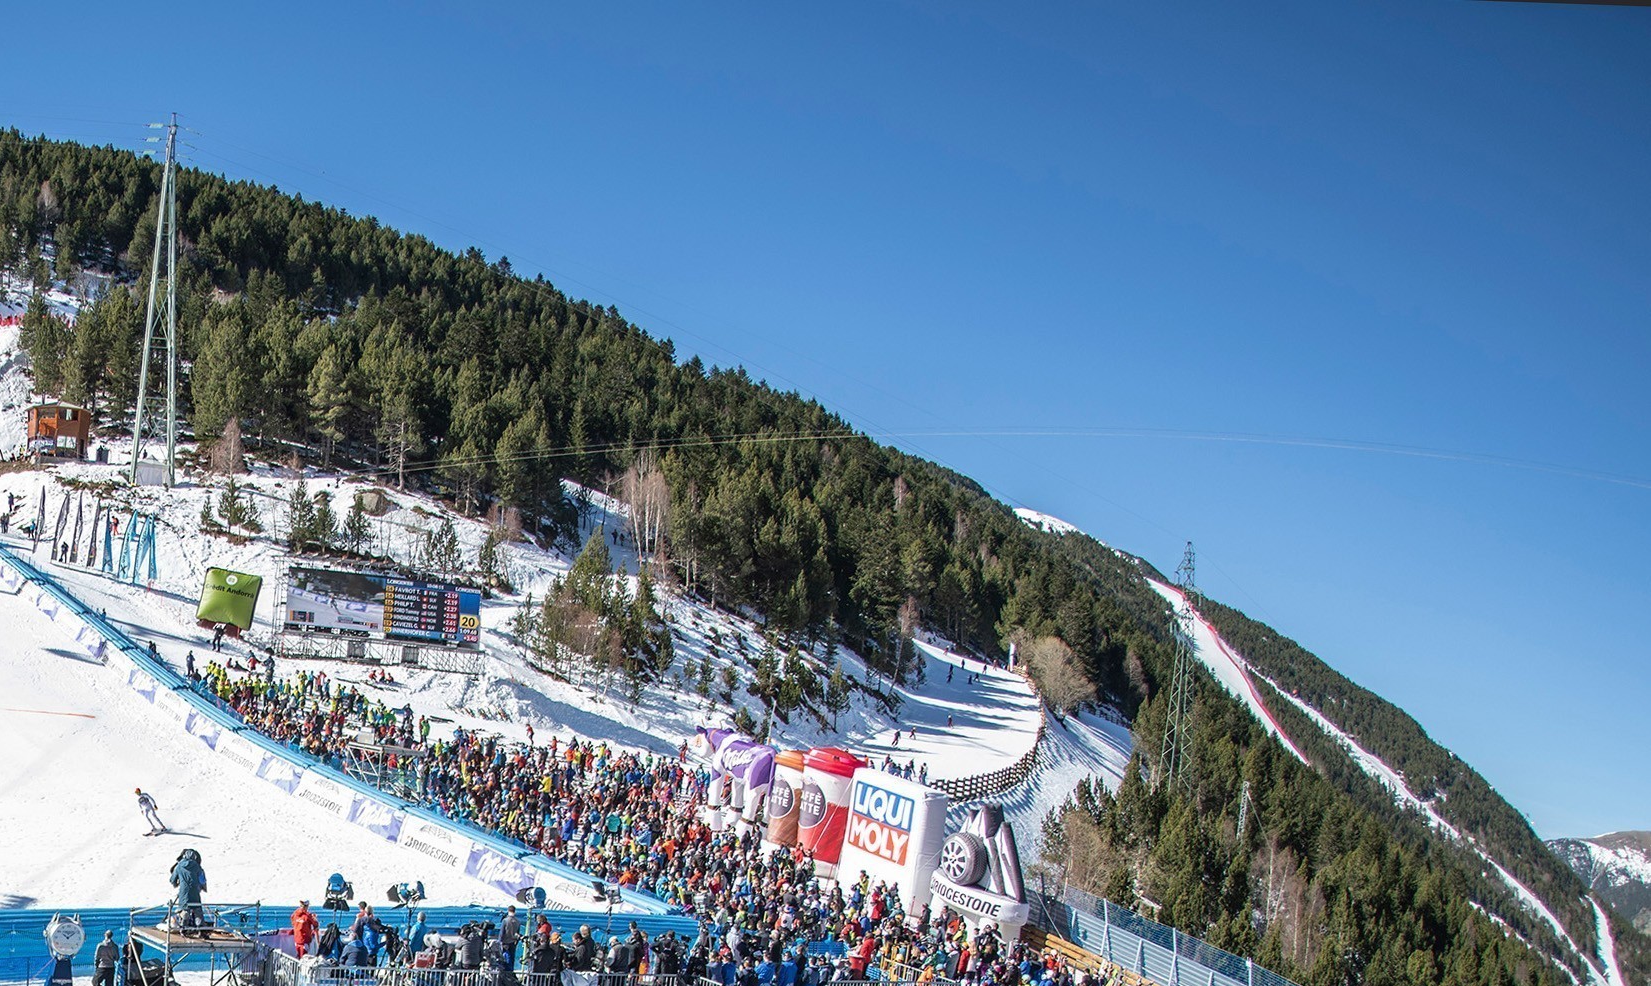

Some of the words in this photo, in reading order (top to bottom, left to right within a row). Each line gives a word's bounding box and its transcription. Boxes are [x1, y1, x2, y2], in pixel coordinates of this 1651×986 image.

[461, 616, 475, 627] 20
[801, 790, 822, 805] AFFÈ
[854, 783, 912, 829] LIQUI
[404, 835, 458, 867] BRIDGESTONE
[849, 815, 909, 863] MOLY
[476, 852, 524, 884] Milka
